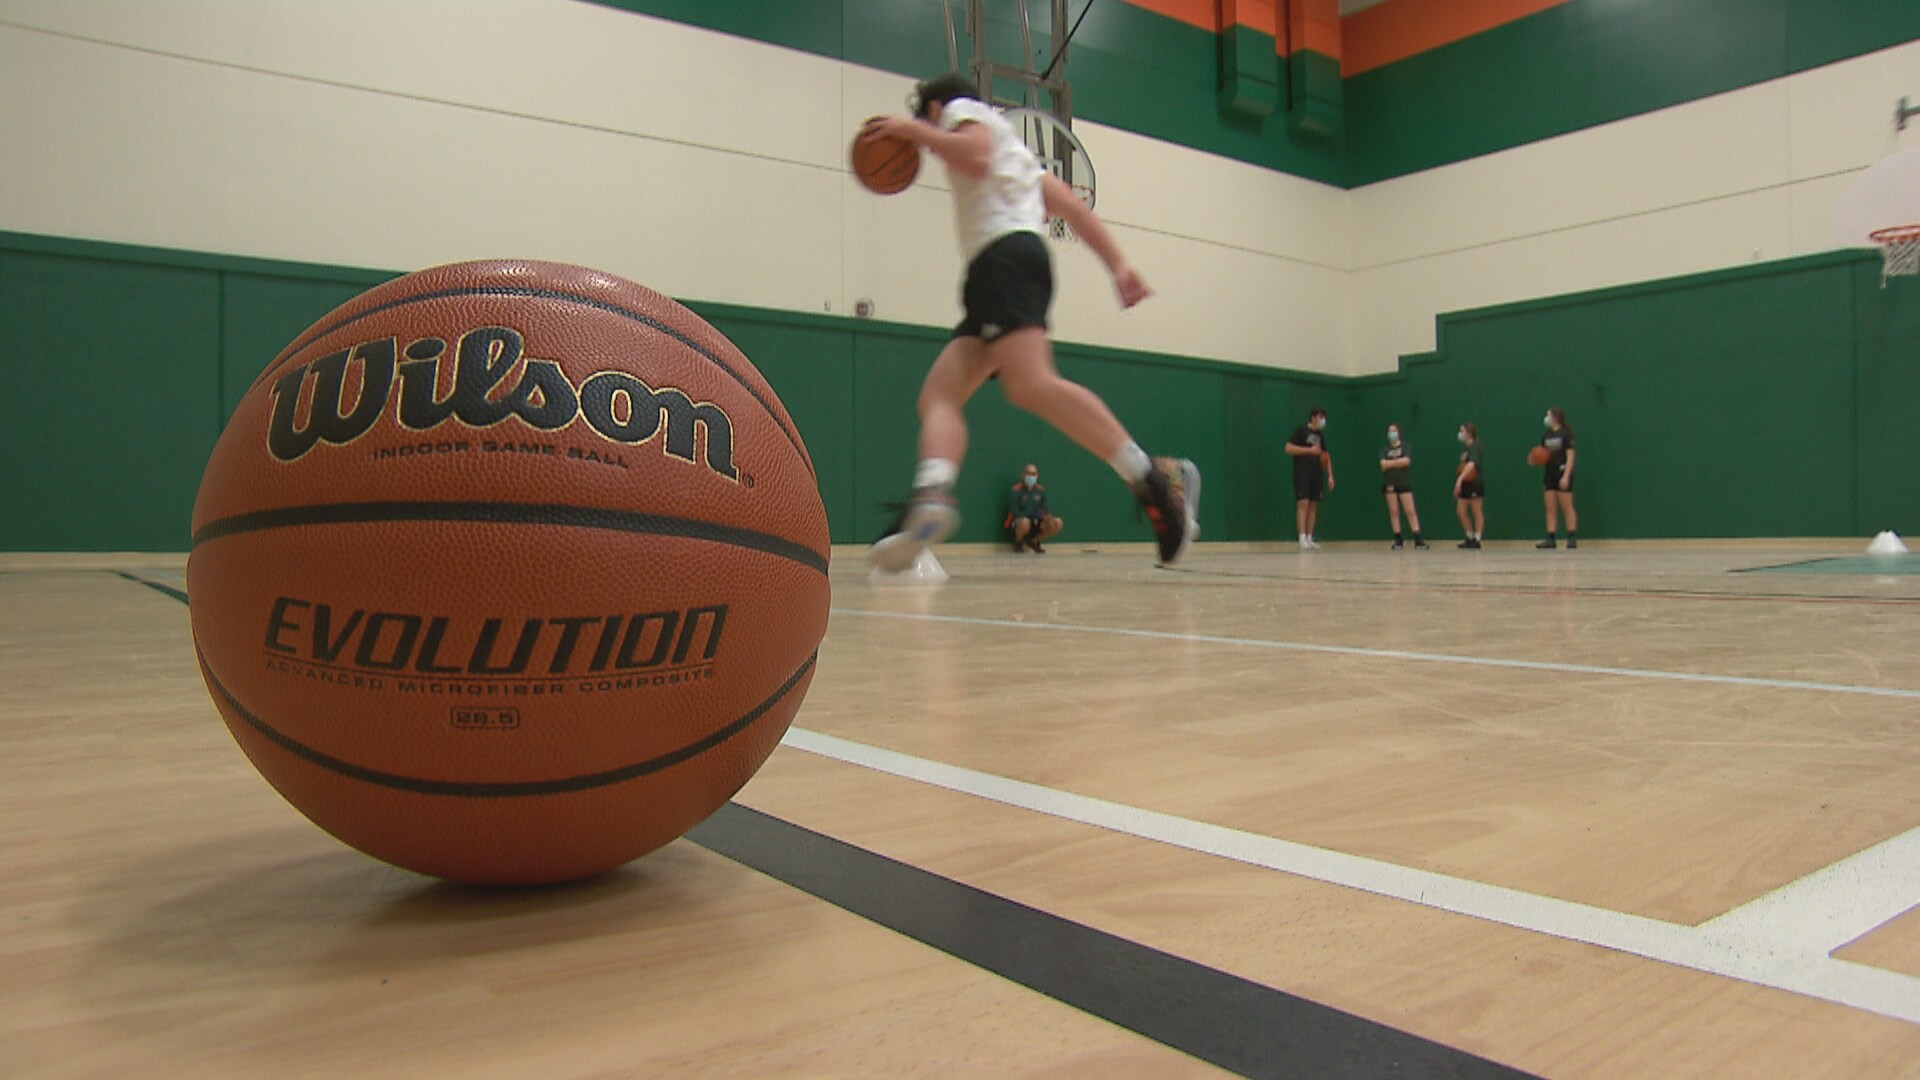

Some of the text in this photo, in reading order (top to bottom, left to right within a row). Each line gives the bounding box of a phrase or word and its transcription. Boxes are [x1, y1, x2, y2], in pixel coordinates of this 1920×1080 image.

[266, 325, 740, 482] Wilson
[373, 441, 630, 469] INDOOR GAME BALL
[265, 596, 729, 675] EVOLUTION
[265, 659, 714, 696] ADVANCED MICROFIBER COMPOSITE
[456, 711, 514, 725] 28.5
